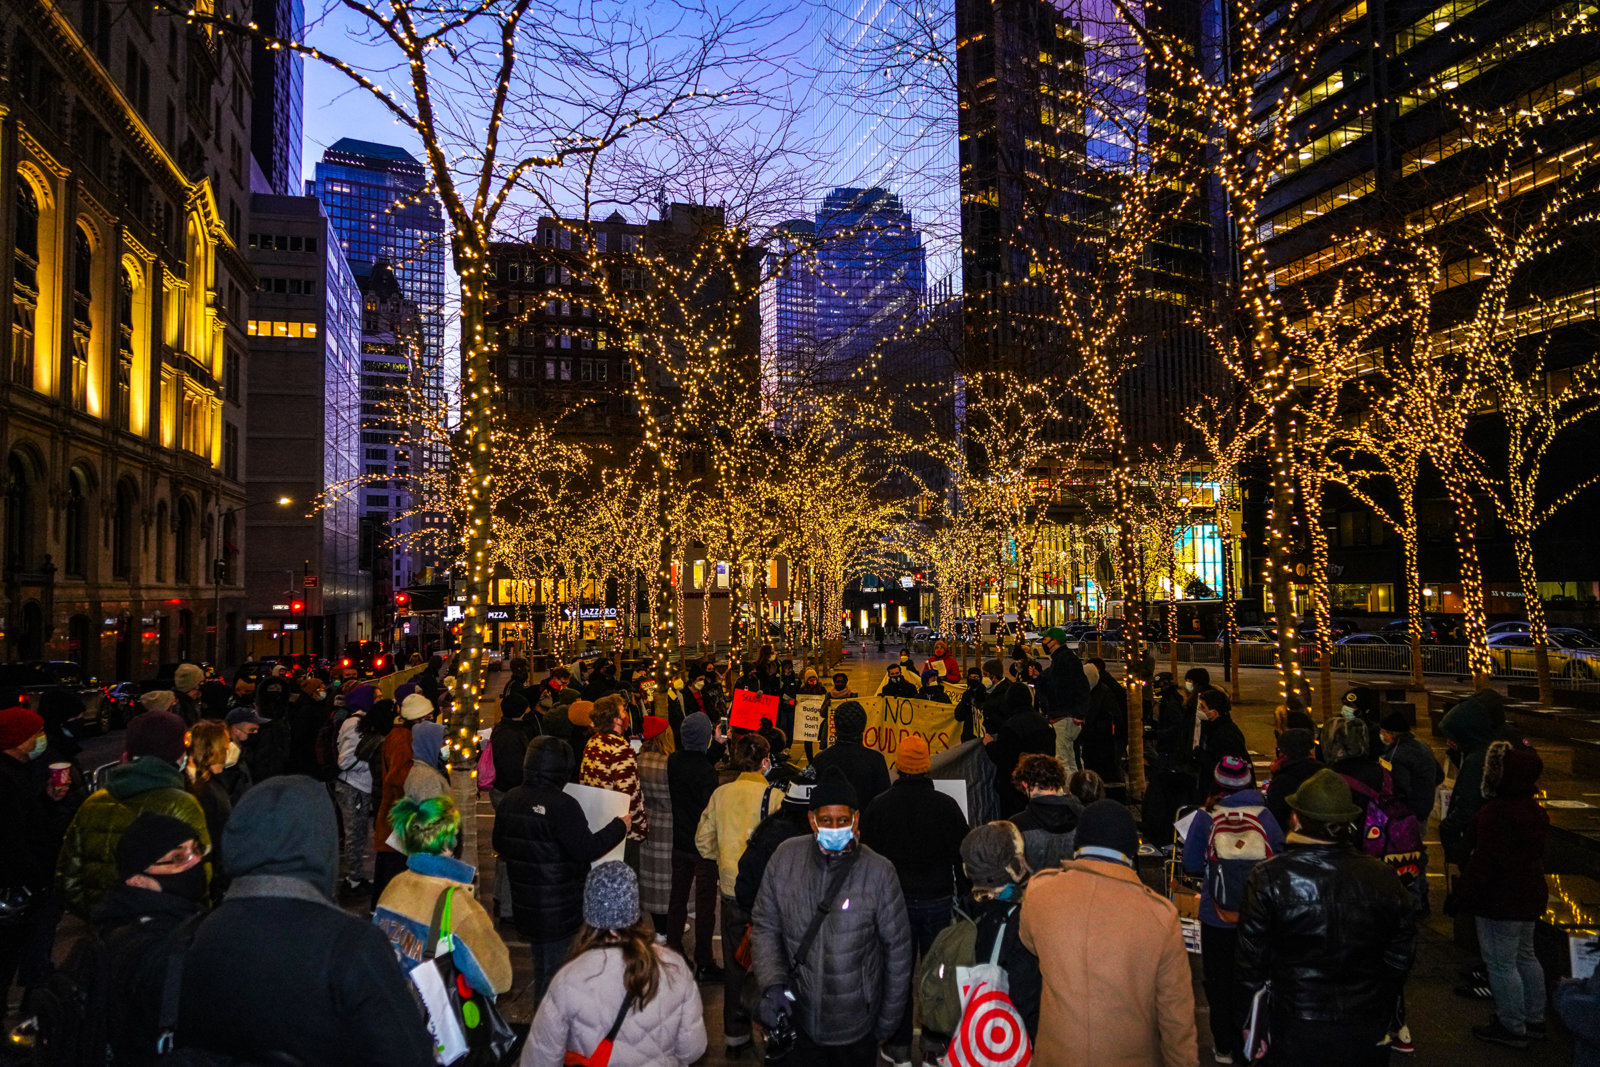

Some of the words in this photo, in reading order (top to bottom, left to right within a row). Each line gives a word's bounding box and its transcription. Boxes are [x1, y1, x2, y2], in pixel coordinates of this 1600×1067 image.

[1306, 563, 1345, 577] Flity
[488, 611, 508, 619] PIZZA
[802, 706, 822, 714] Budge
[885, 697, 913, 725] NO
